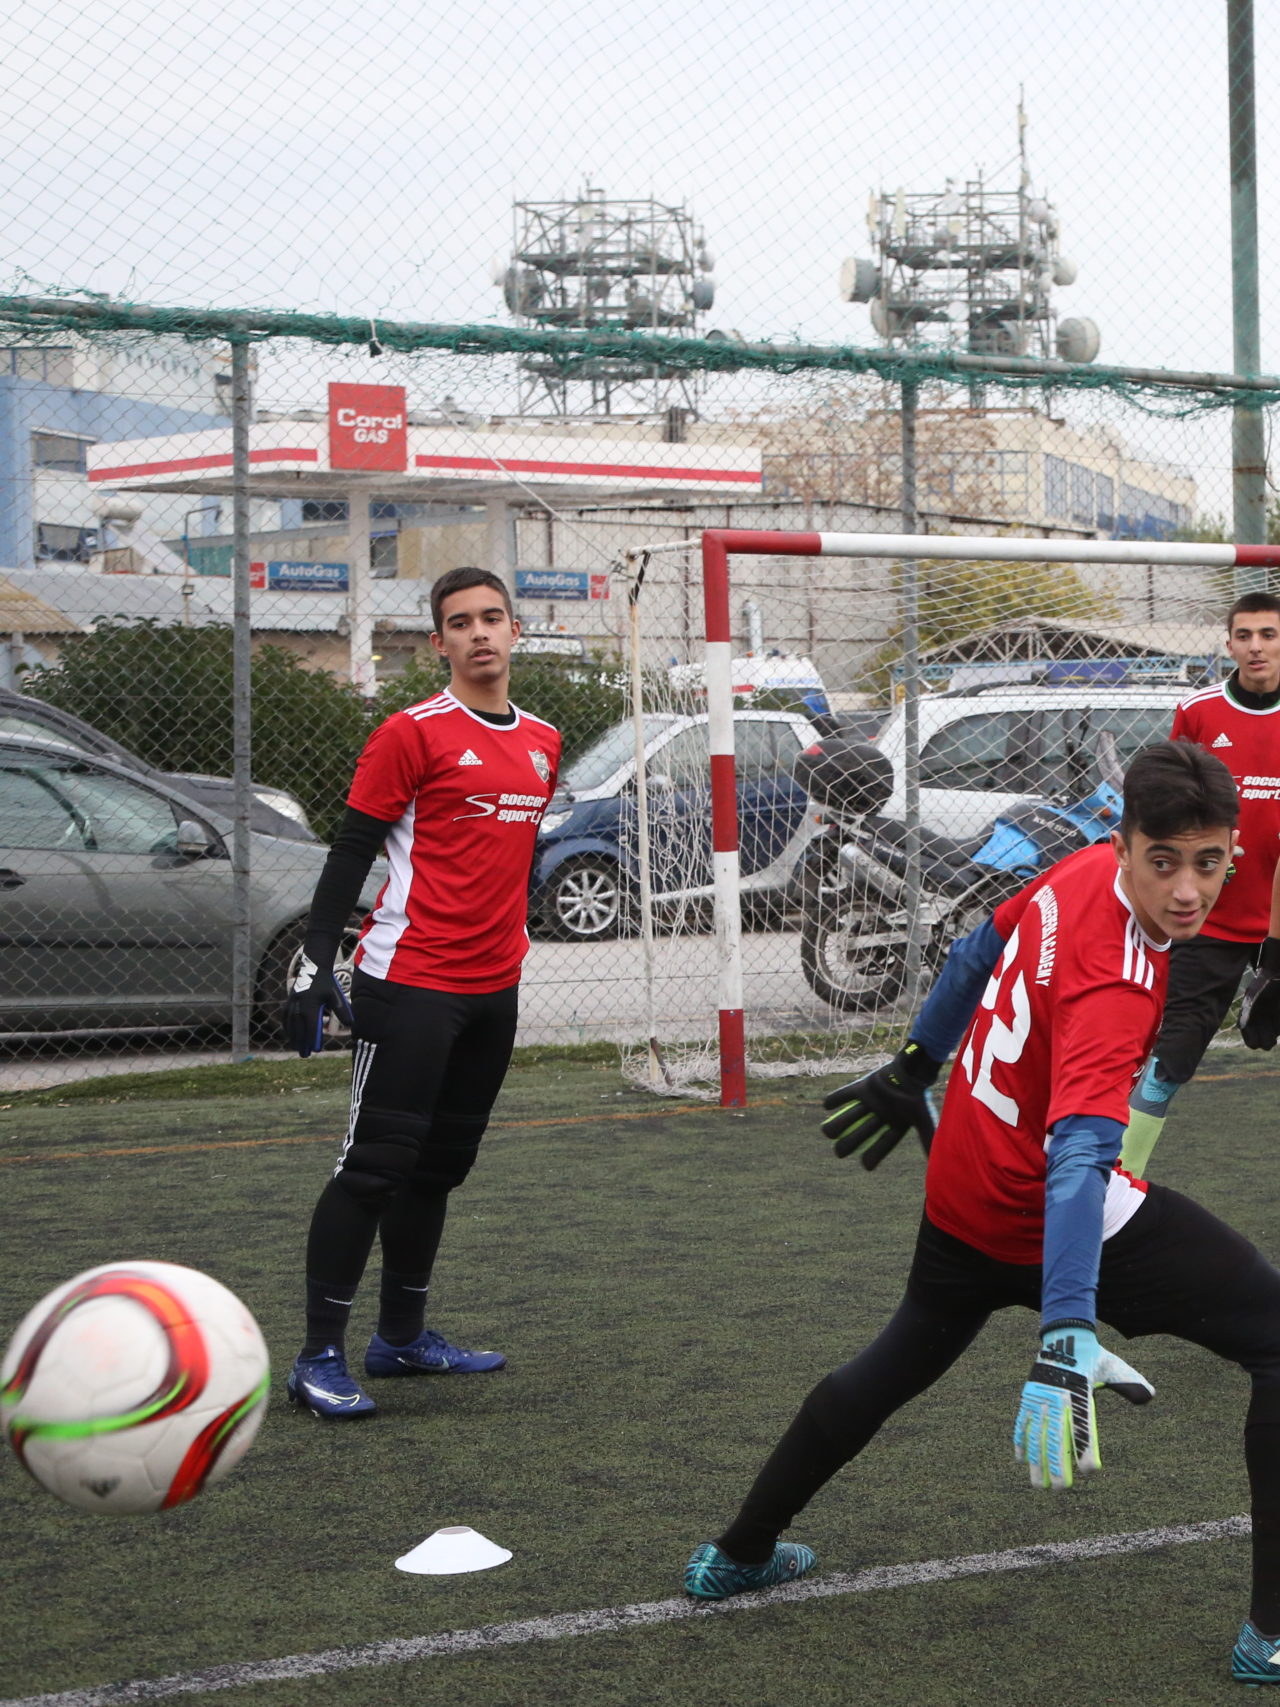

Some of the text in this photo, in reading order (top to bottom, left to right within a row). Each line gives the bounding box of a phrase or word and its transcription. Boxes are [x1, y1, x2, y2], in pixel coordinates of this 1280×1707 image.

[337, 407, 403, 430] Coral
[353, 428, 389, 444] GAS
[279, 563, 340, 578] AutoGas
[524, 573, 580, 586] AutoGas
[498, 793, 548, 808] soccer
[1035, 935, 1058, 987] ACADEMY
